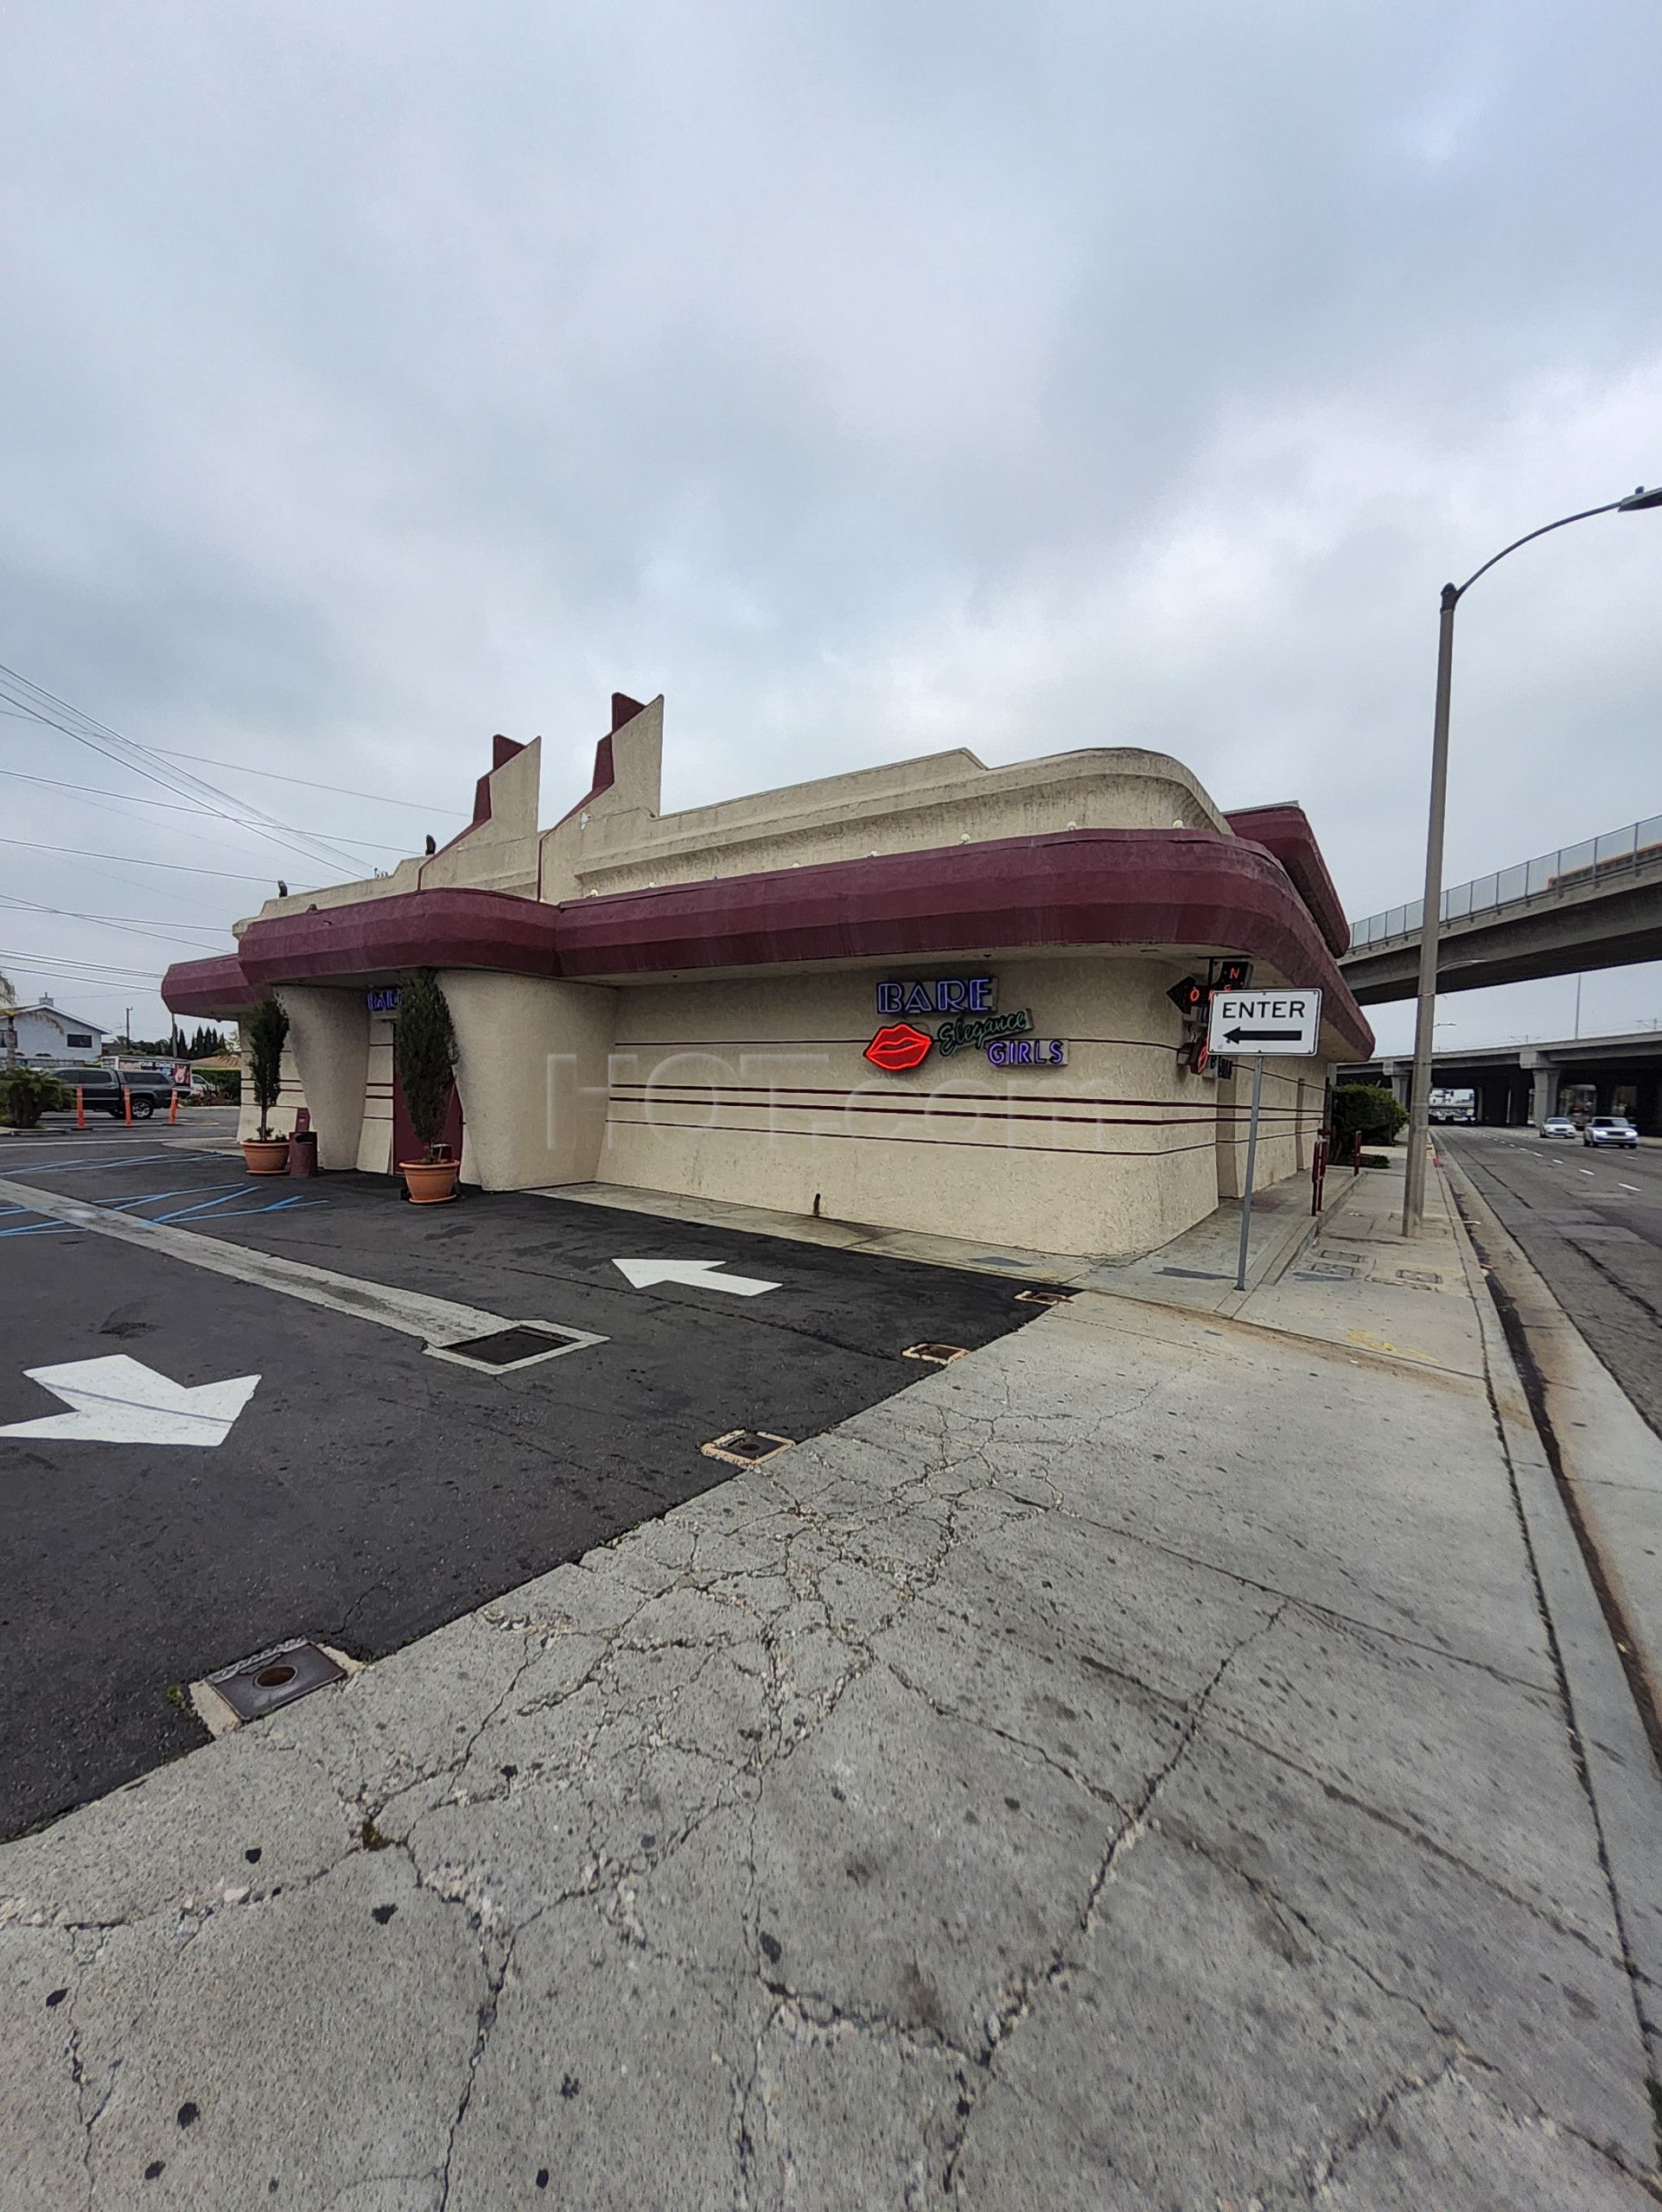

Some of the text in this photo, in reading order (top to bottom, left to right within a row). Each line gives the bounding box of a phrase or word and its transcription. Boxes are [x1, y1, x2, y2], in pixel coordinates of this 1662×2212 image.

[877, 978, 992, 1014] BARE
[1222, 1001, 1306, 1019] ENTER
[938, 1009, 1028, 1057] Elegance
[986, 1039, 1064, 1065] GIRLS
